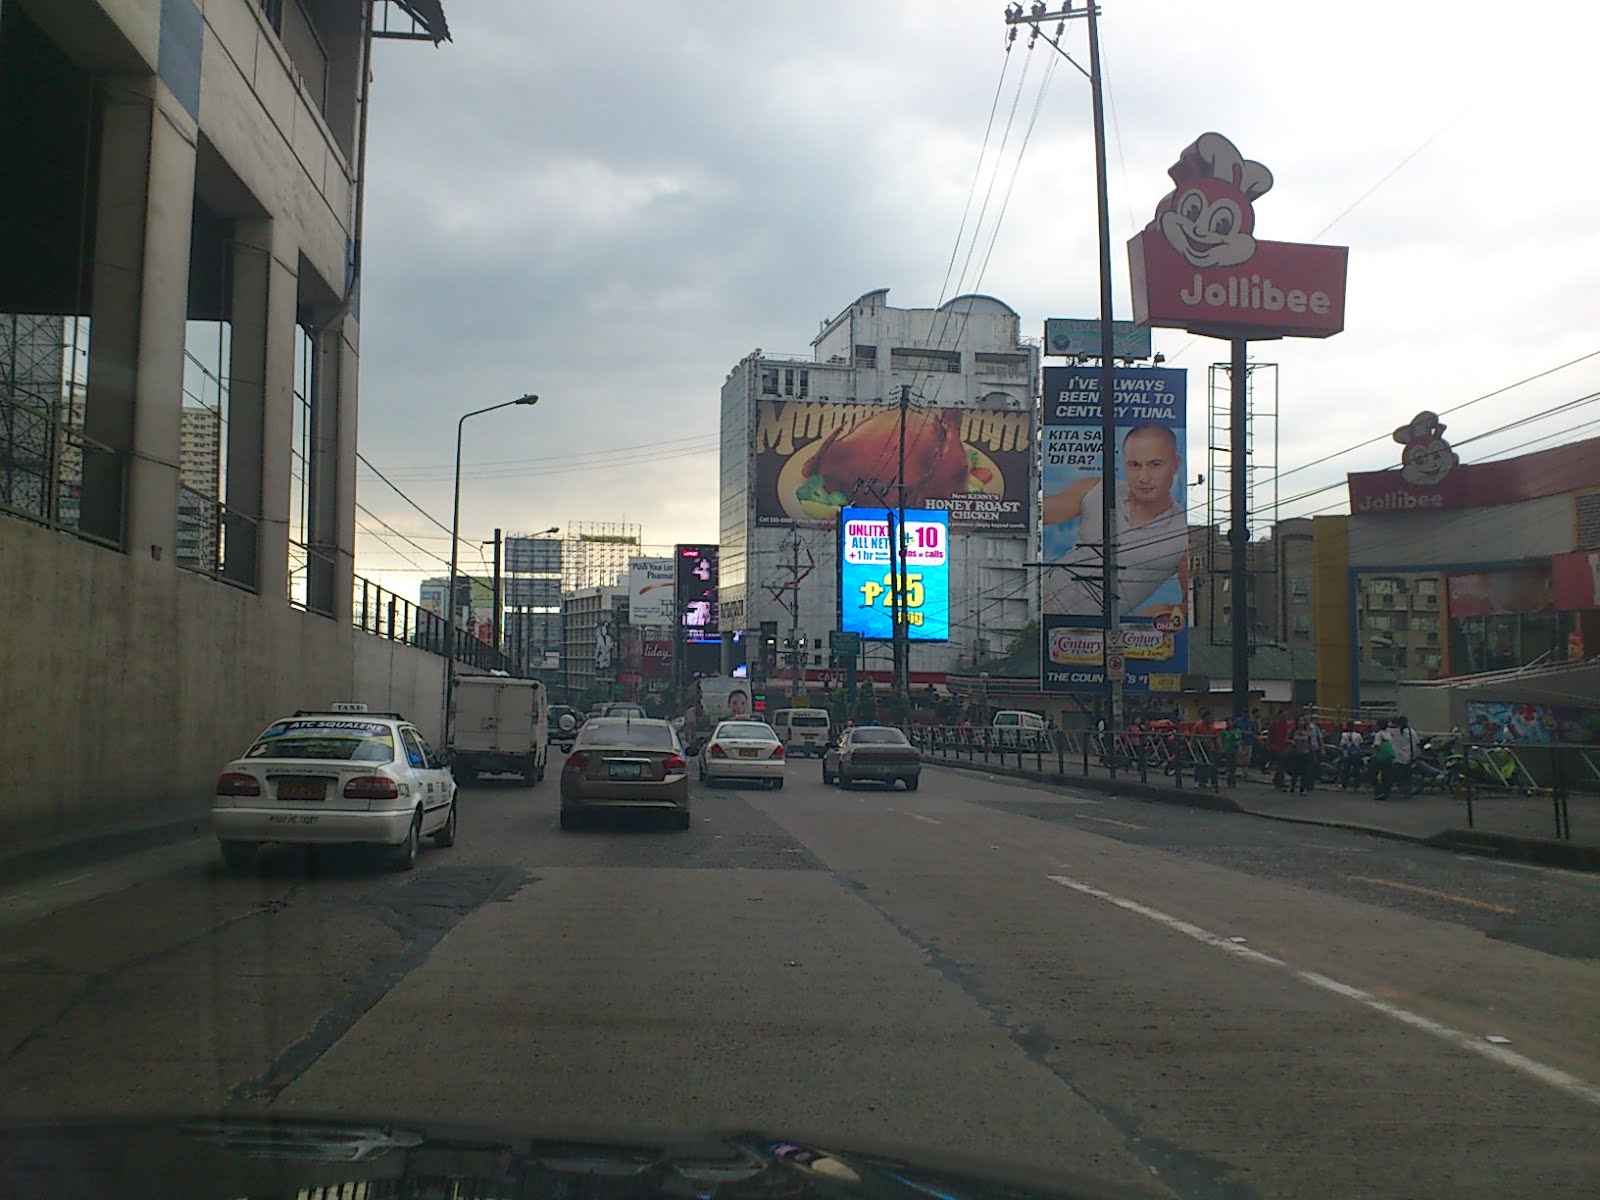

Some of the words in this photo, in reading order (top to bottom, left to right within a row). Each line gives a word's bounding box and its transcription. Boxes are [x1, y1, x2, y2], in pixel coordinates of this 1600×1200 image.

[1180, 274, 1330, 314] Jollibee
[1068, 376, 1098, 390] I'VE
[1100, 379, 1165, 391] LWAYS
[1058, 392, 1098, 403] BEEN
[1110, 393, 1149, 404] OYAL
[1154, 393, 1174, 405] TO
[1056, 406, 1129, 418] CENTUY
[1048, 431, 1079, 440] KITA
[1083, 431, 1102, 440] SA
[1067, 454, 1094, 465] BA?
[924, 499, 974, 512] HONEY
[975, 500, 1020, 513] ROAST
[1358, 490, 1443, 511] Jollibee
[952, 511, 1000, 521] CHICKEN
[852, 537, 868, 549] ALL
[925, 550, 944, 558] calls
[1058, 636, 1103, 652] Century
[1122, 631, 1162, 646] Century
[1047, 672, 1069, 682] THE
[317, 721, 384, 734] SQUALENE
